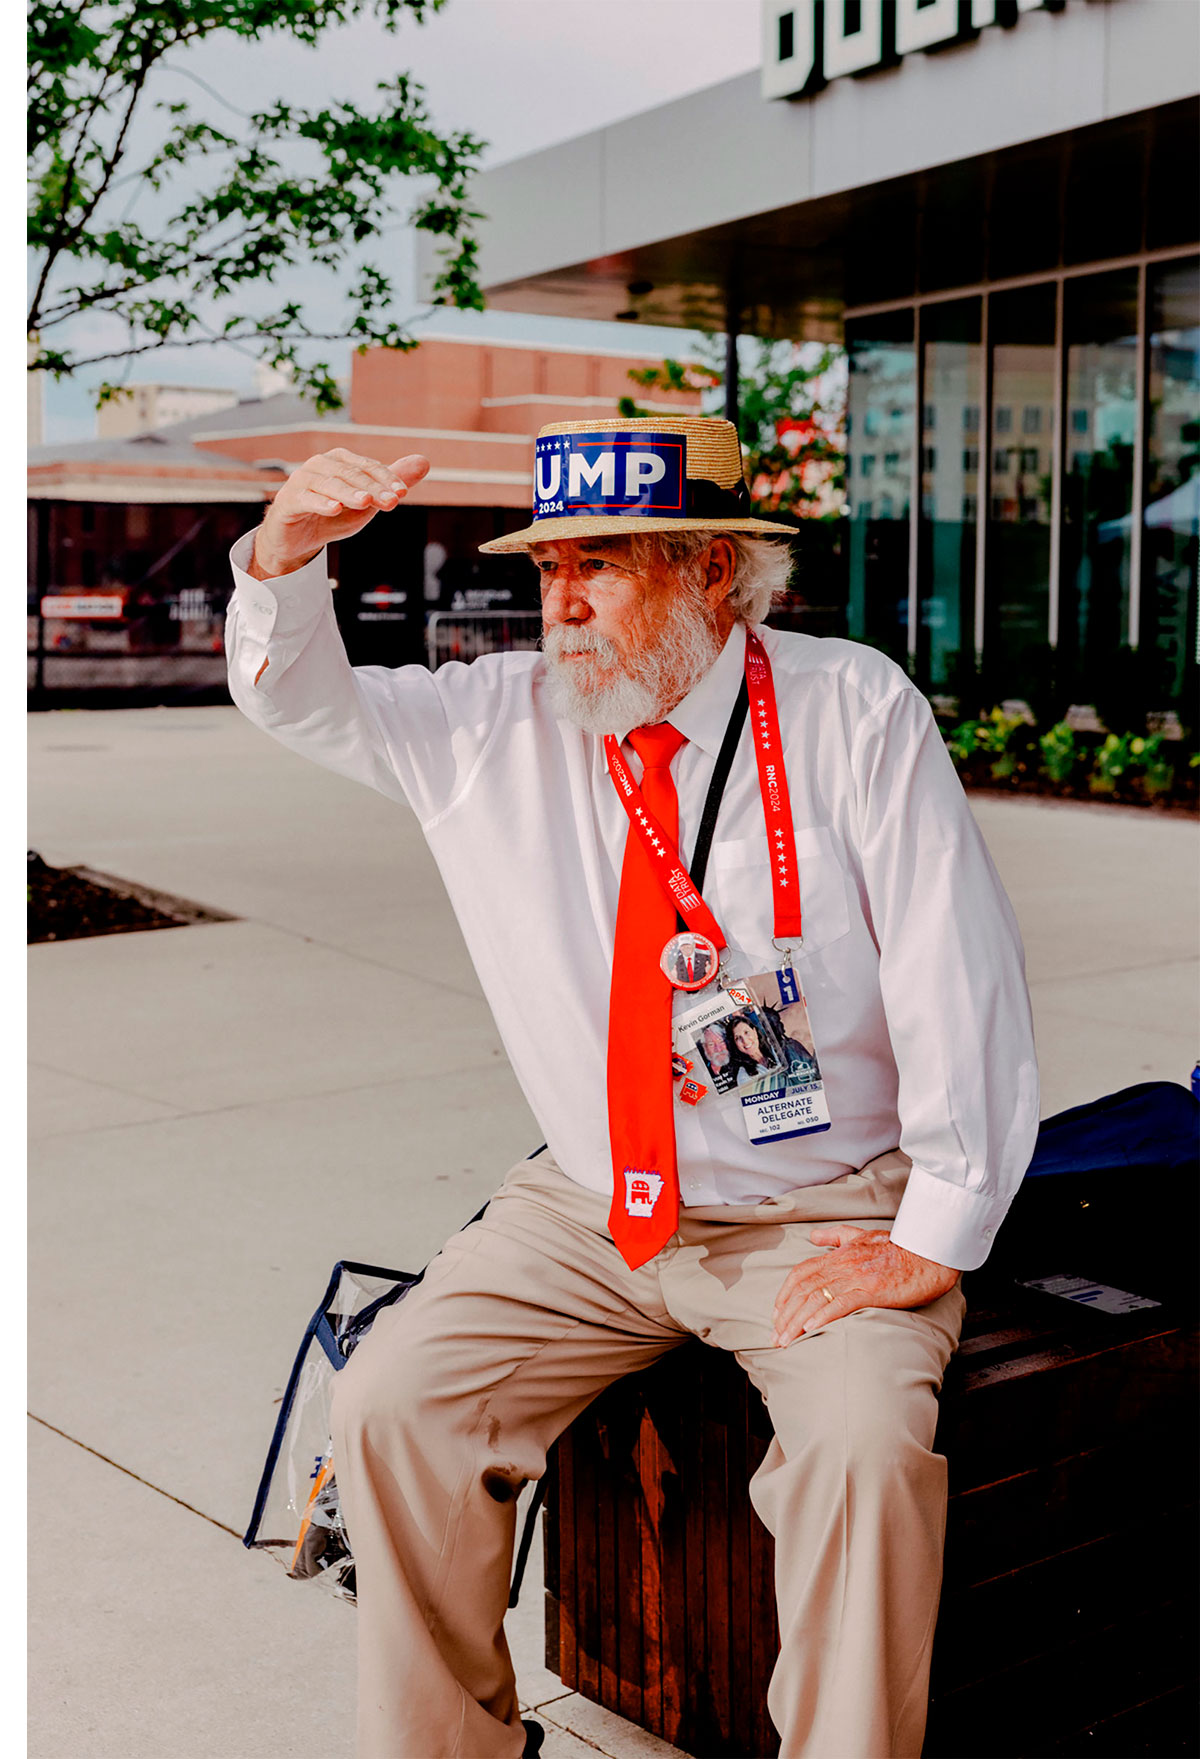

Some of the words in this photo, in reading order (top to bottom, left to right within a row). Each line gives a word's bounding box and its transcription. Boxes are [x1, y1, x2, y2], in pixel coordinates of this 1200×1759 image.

[534, 451, 666, 501] UMP
[539, 500, 565, 515] 2024
[611, 754, 634, 797] RNC2024
[765, 764, 782, 812] RNC2024
[667, 876, 686, 900] DATA
[670, 868, 692, 895] TRUST
[677, 1020, 698, 1033] Kevin
[698, 1005, 725, 1023] Gorman
[744, 1091, 780, 1104] MONDAY
[791, 1085, 808, 1095] JULY
[757, 1096, 813, 1116] ALTERNATE
[761, 1106, 812, 1124] DELEGATE
